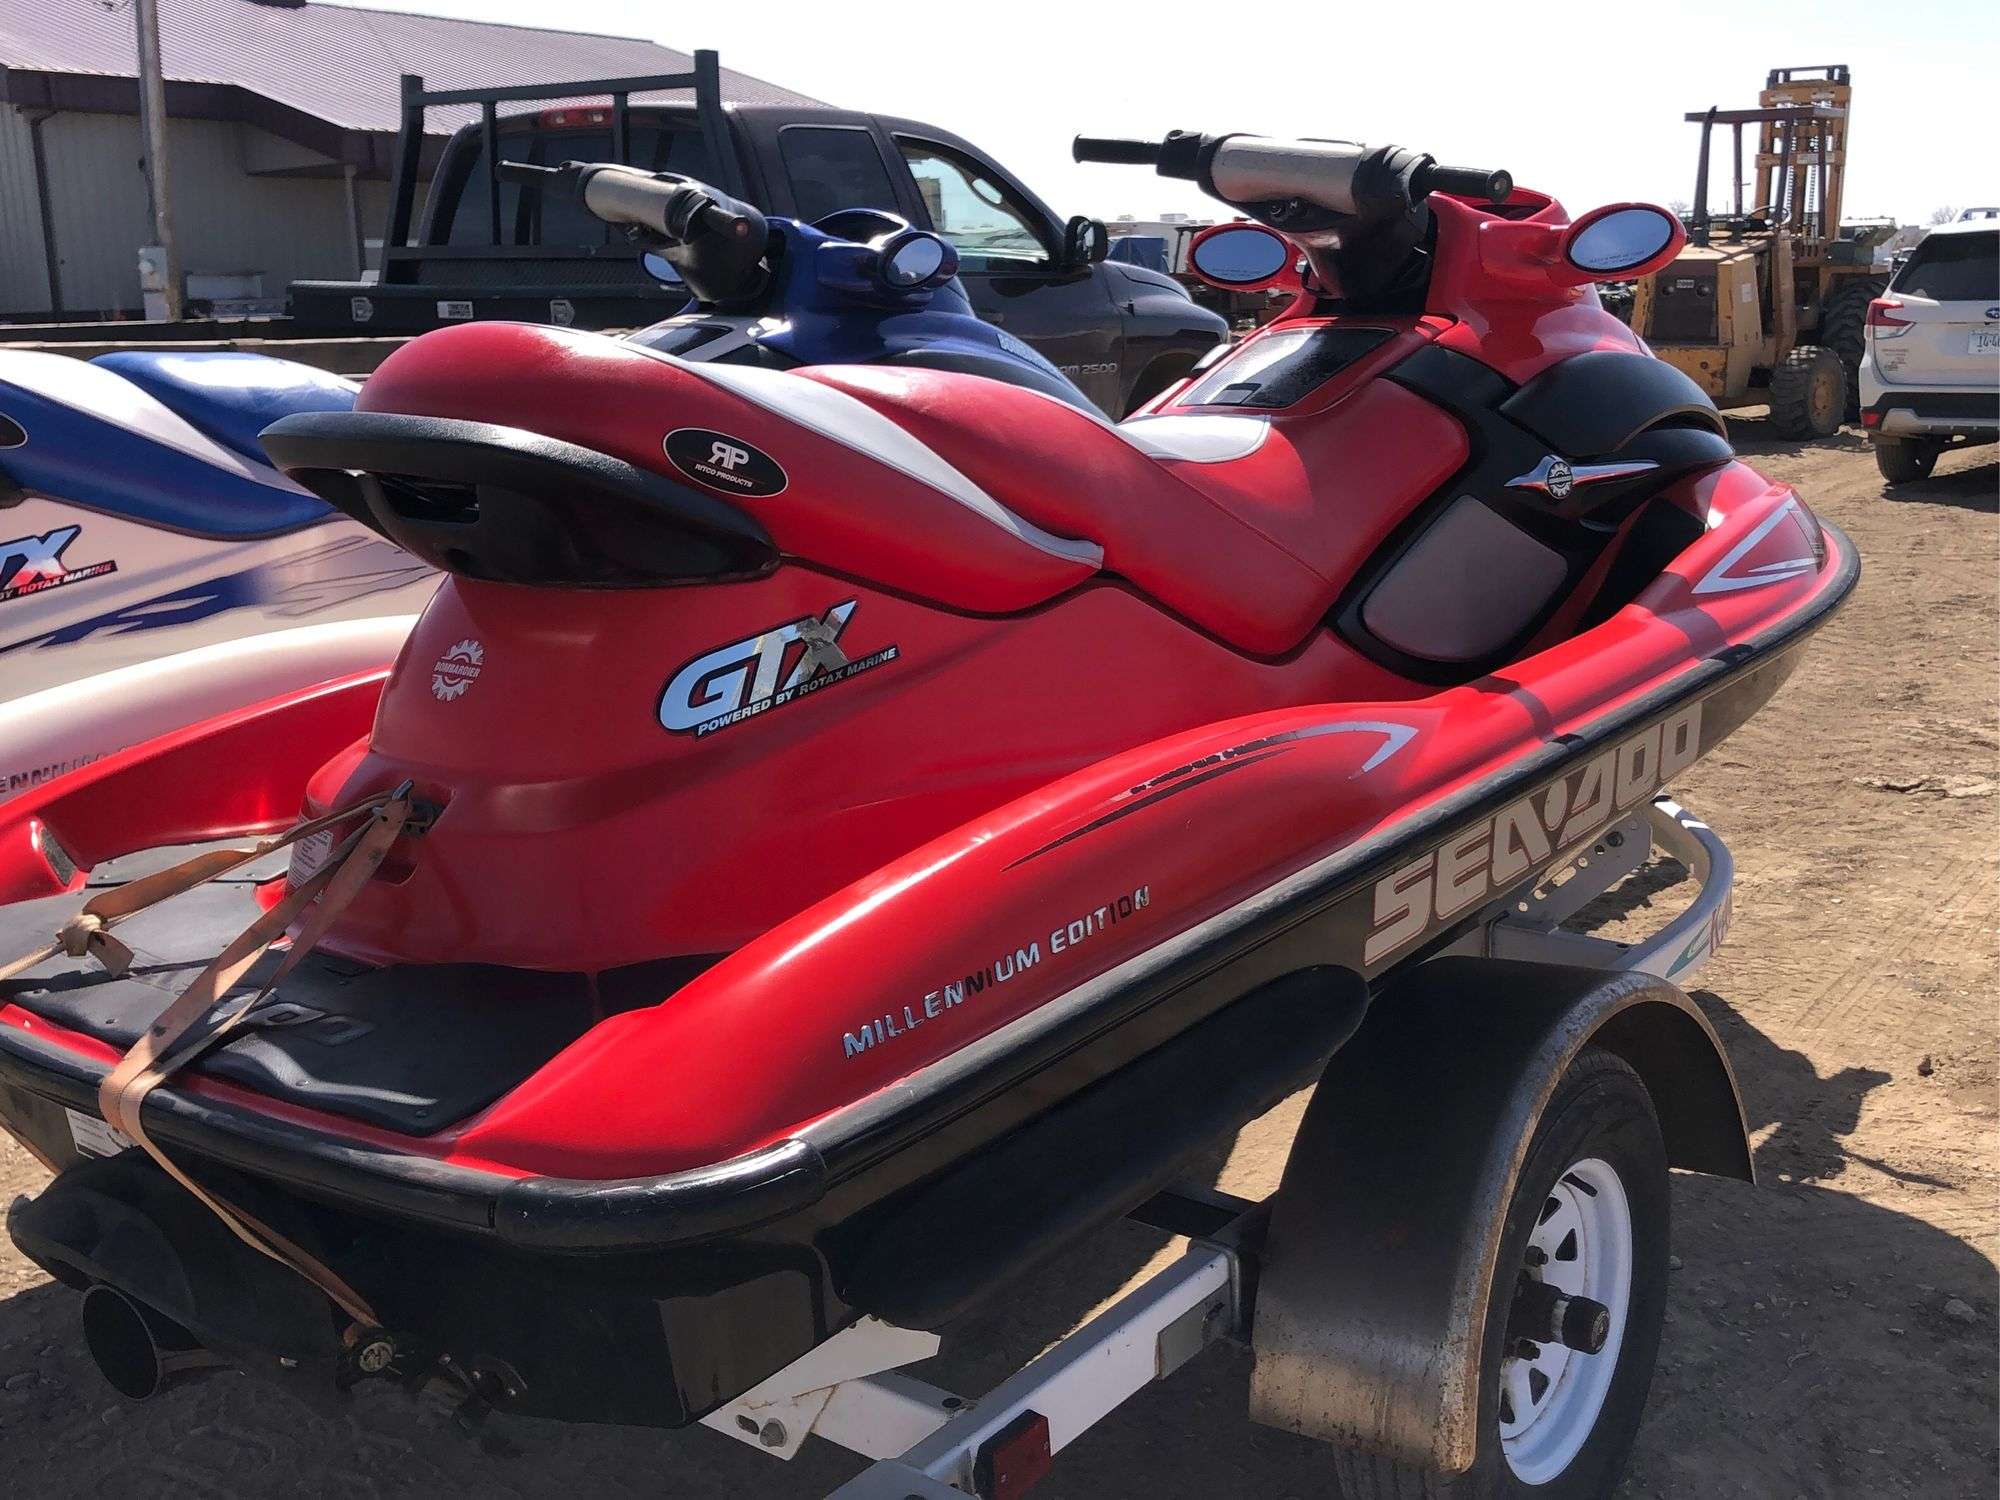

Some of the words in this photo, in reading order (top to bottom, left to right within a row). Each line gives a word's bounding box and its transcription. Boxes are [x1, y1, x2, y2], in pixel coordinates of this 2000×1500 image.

[1082, 362, 1118, 375] 2500
[695, 463, 716, 476] RITCO
[715, 471, 753, 488] PRODUCTS
[18, 576, 61, 595] ROTAX
[63, 563, 112, 582] MARINE
[660, 600, 857, 730] GTX
[698, 700, 771, 736] POWERED
[776, 689, 795, 705] BY
[799, 670, 843, 696] ROTAX
[847, 648, 896, 677] MARINE
[843, 942, 1040, 1059] MILLENNIUM
[1050, 885, 1149, 955] EDITION
